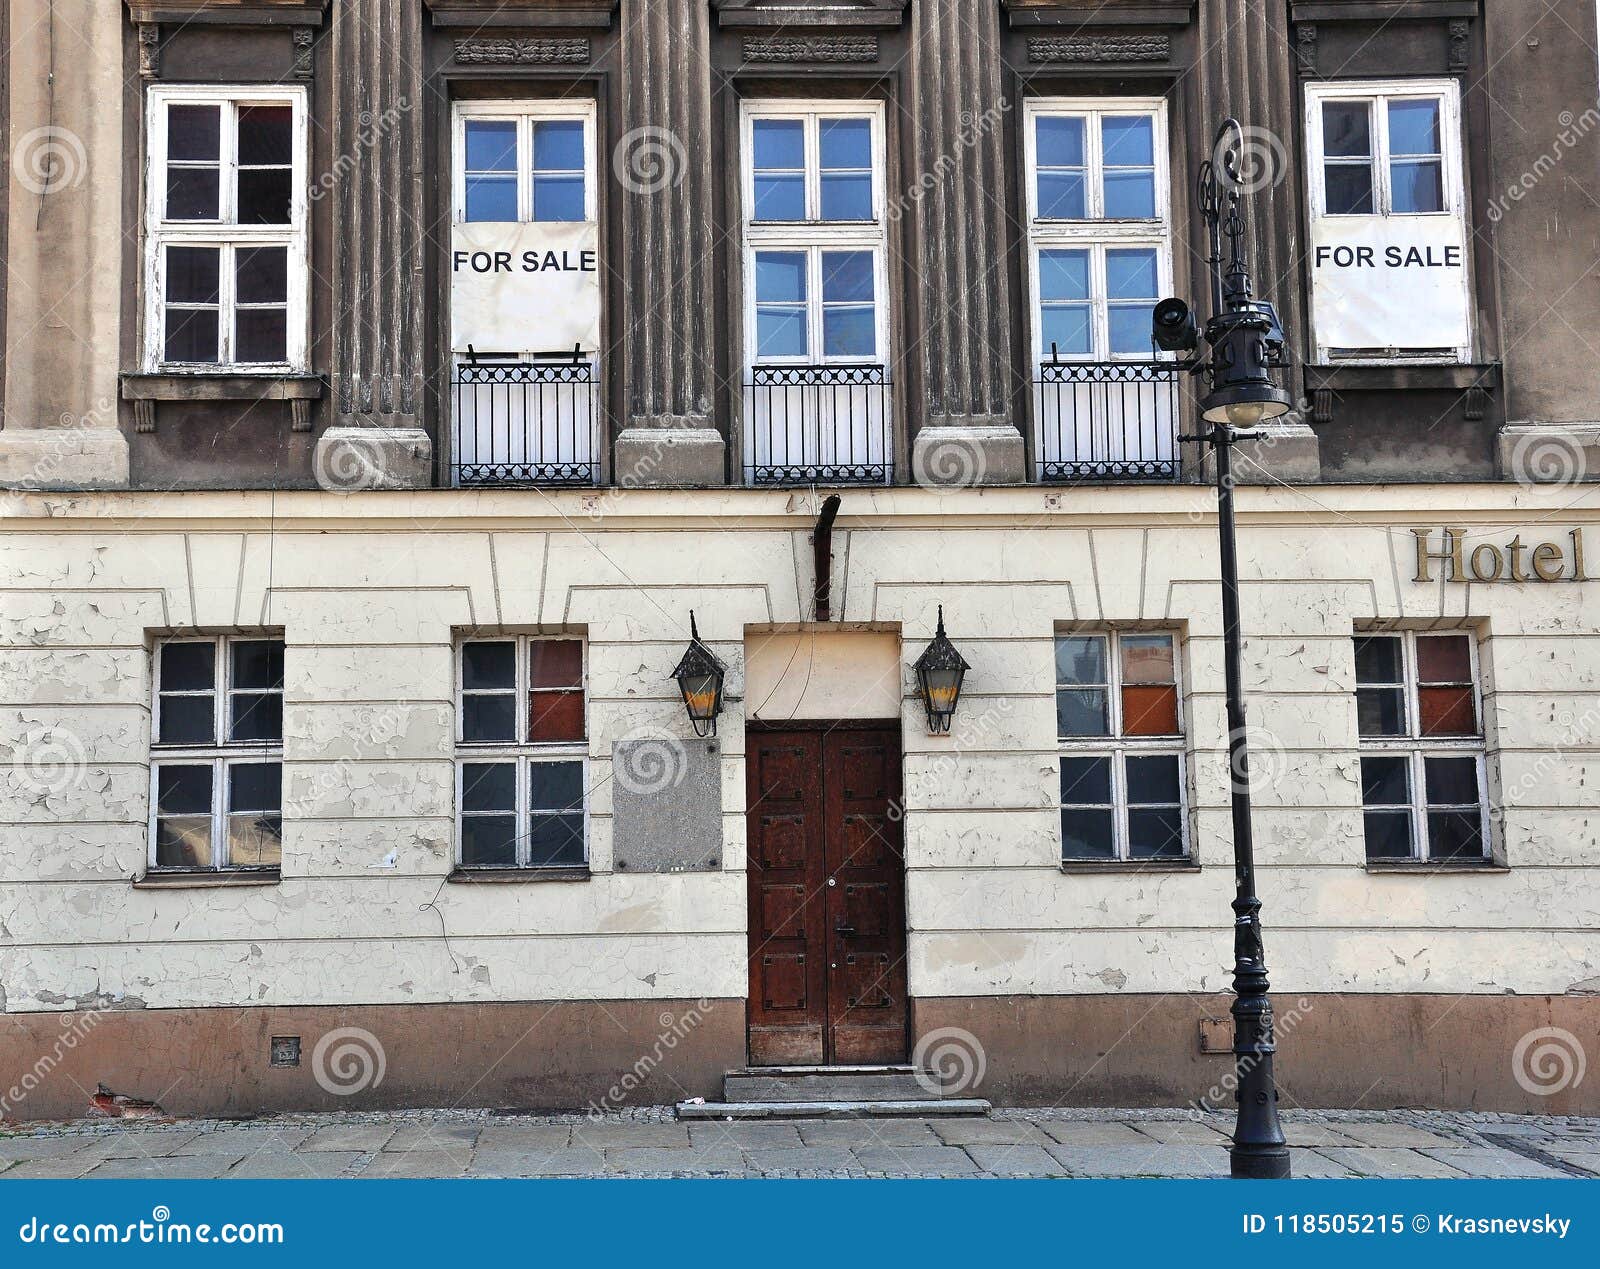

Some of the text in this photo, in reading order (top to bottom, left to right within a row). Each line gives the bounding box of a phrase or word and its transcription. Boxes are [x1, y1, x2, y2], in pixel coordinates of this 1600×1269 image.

[453, 250, 597, 273] FOR SALE
[1316, 245, 1461, 267] FOR SALE
[1409, 527, 1591, 583] Hotel
